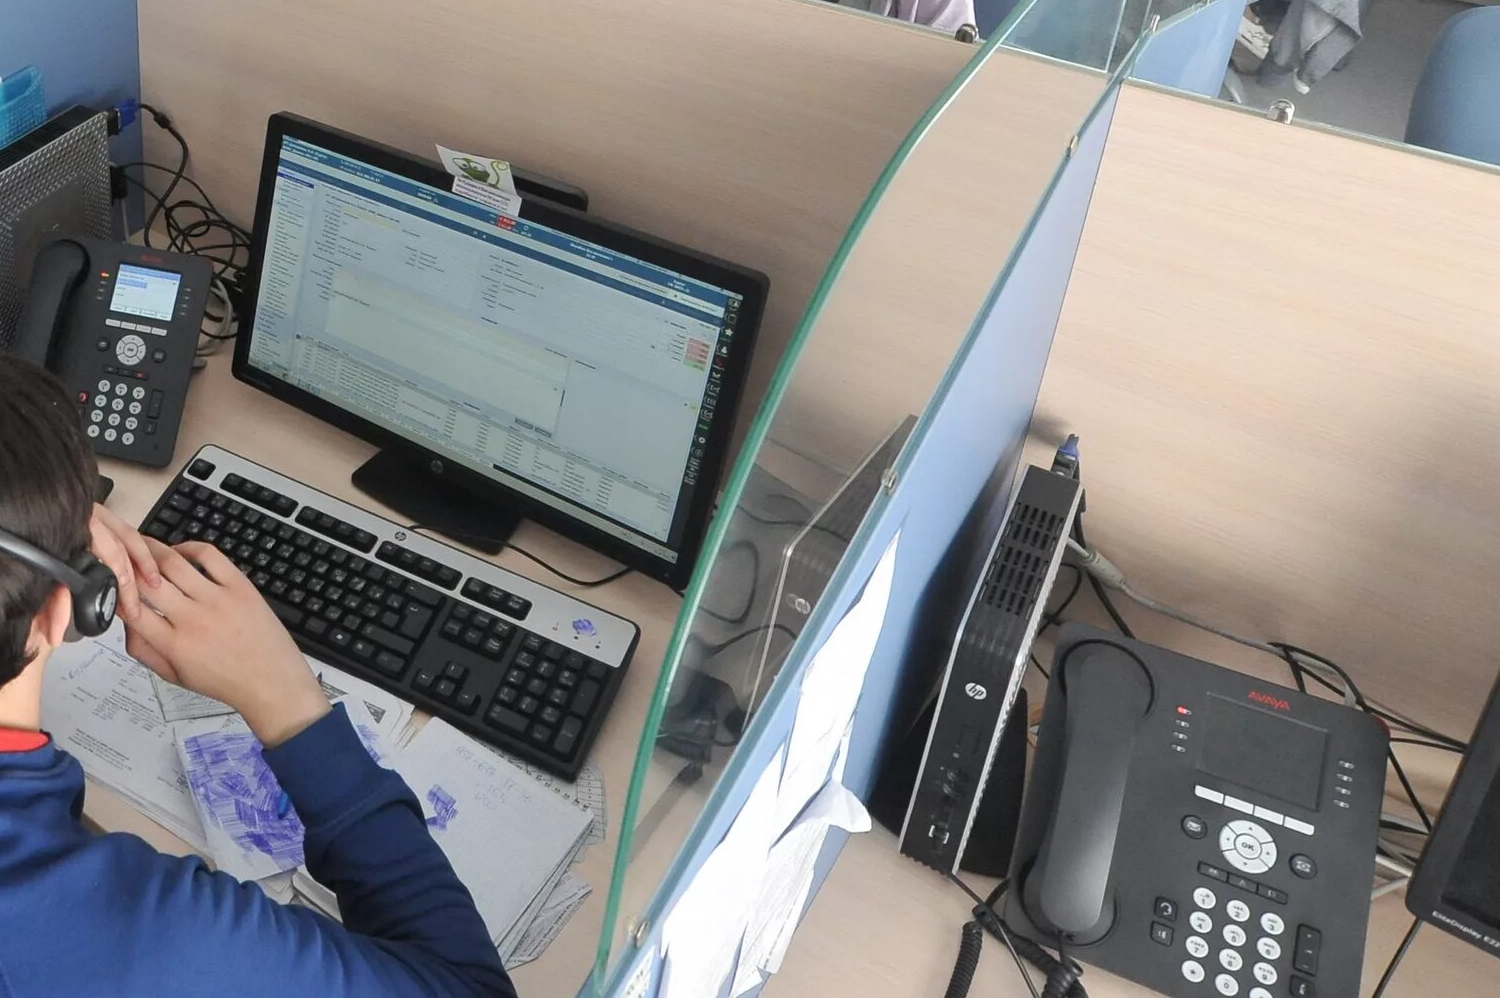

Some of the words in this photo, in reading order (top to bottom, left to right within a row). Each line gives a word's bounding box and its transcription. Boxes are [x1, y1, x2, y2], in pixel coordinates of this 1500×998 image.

[965, 682, 988, 700] hp
[1248, 691, 1291, 711] AVAYA
[1241, 841, 1255, 851] OK
